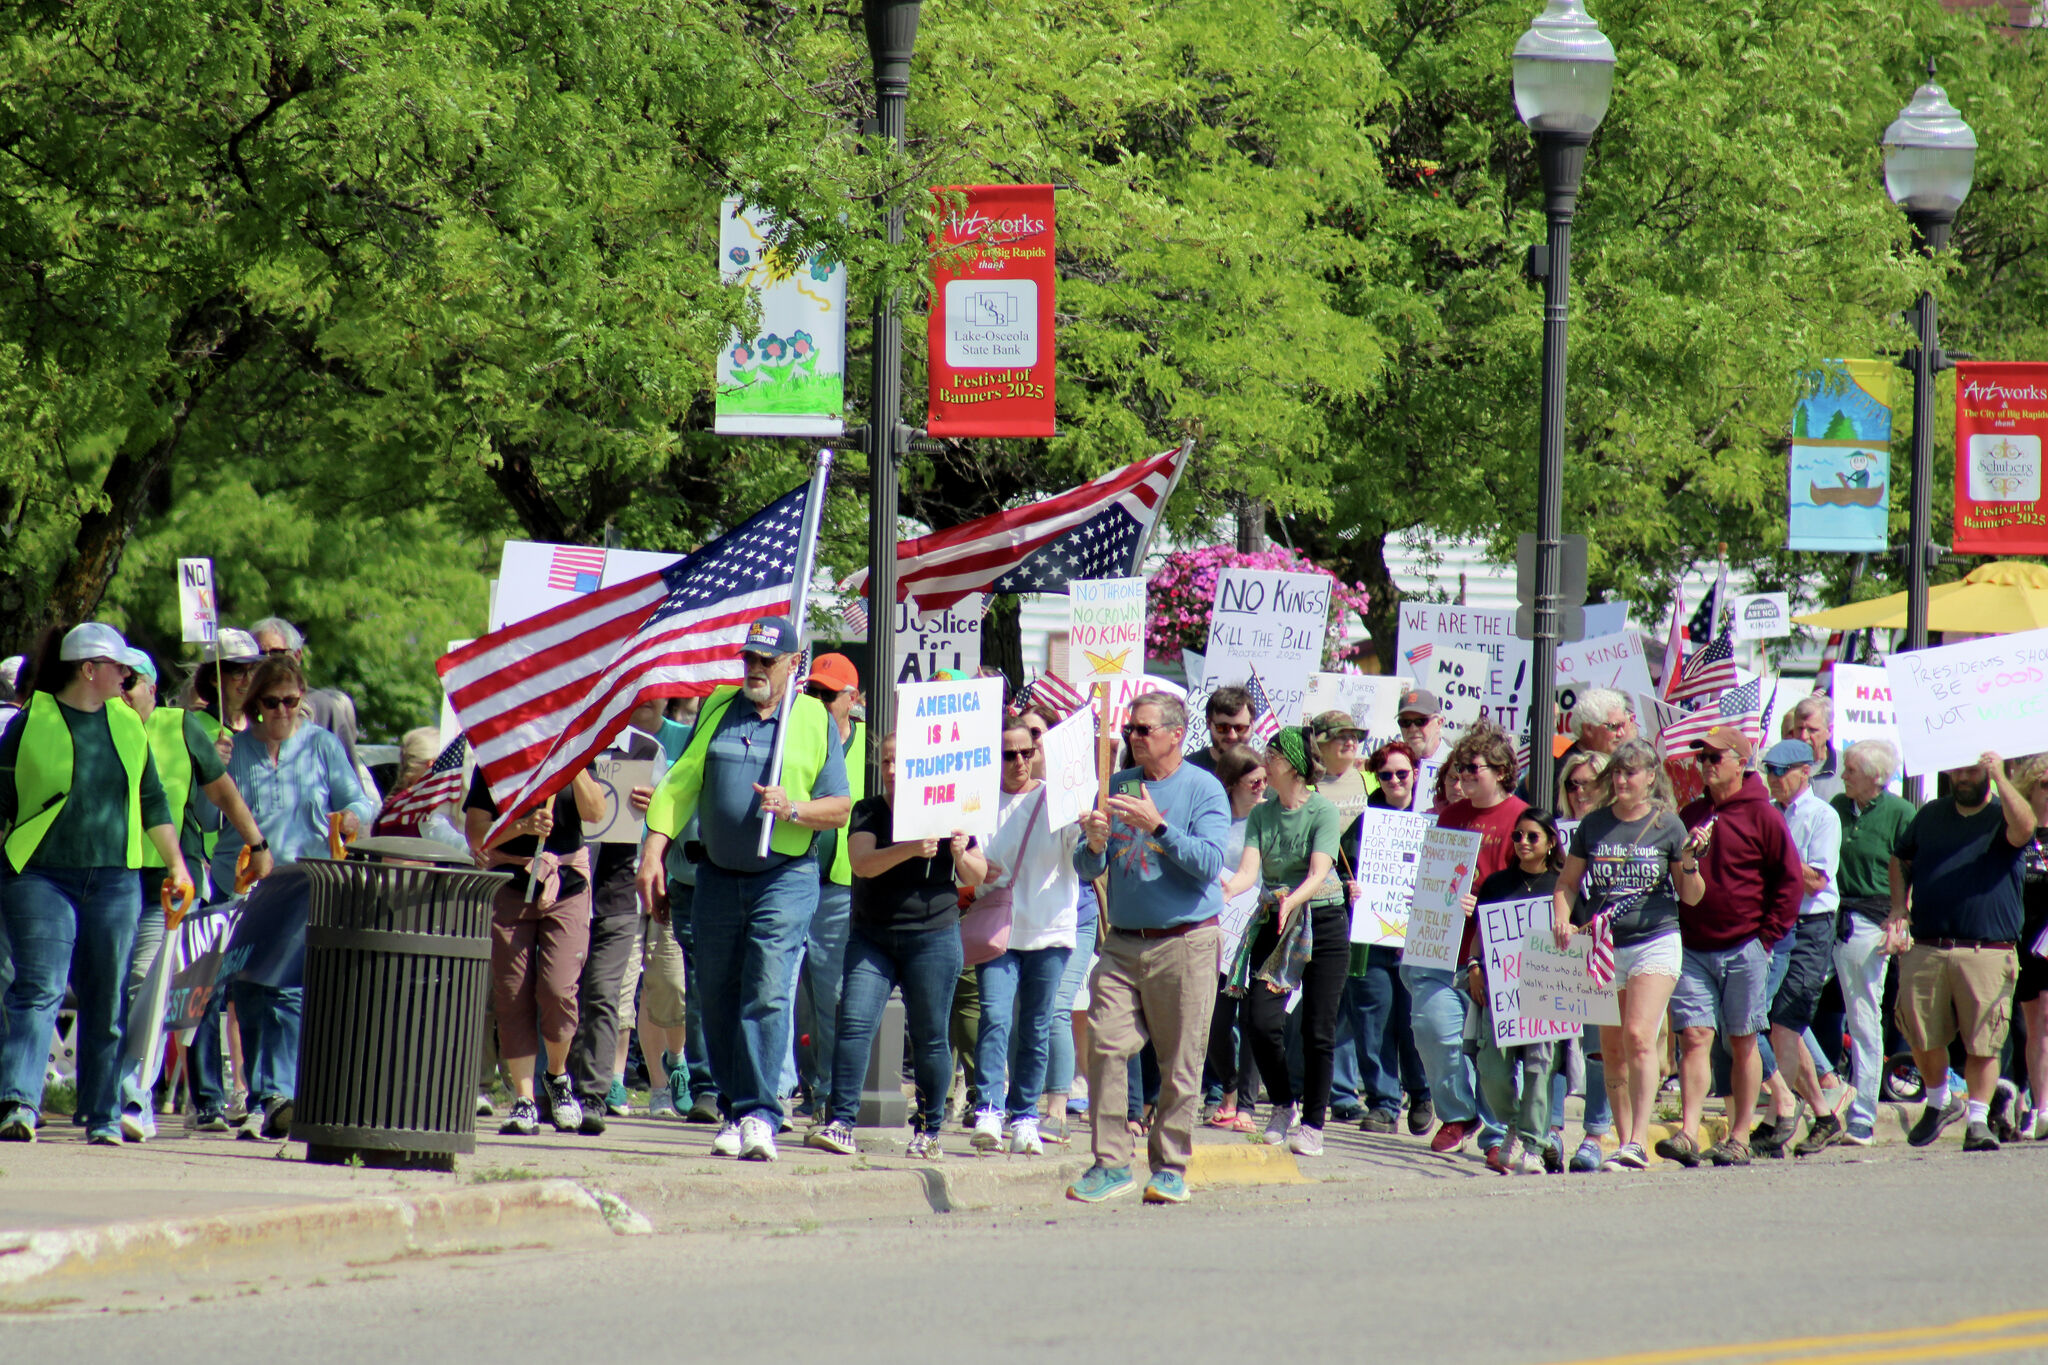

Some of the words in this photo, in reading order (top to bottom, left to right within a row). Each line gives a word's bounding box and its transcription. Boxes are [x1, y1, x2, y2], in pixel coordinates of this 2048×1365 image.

[1013, 247, 1046, 259] Rapids
[955, 330, 1029, 342] Lake-Osceola
[962, 344, 989, 355] State
[993, 344, 1021, 355] Bank
[953, 369, 1012, 388] Festival
[1016, 368, 1032, 382] of
[940, 387, 1002, 404] Banners
[1006, 383, 1044, 399] 2025
[1964, 380, 2048, 402] Artworks
[1963, 408, 1979, 418] The
[1980, 409, 1996, 420] City
[1997, 409, 2007, 418] of
[1975, 502, 2021, 517] Festival
[2023, 501, 2036, 513] of
[1963, 515, 2013, 529] Banners
[2016, 512, 2047, 527] 2025
[184, 564, 206, 588] NO
[1076, 584, 1098, 601] NO
[1101, 582, 1144, 601] THRONE
[1219, 578, 1265, 612] NO
[1073, 607, 1094, 624] NO
[1096, 604, 1140, 625] CROWN
[1762, 609, 1777, 617] NOT
[1405, 610, 1428, 631] WE
[1438, 612, 1468, 634] ARE
[1473, 614, 1502, 636] THE
[1750, 621, 1776, 630] KINGS
[1071, 624, 1097, 646] NO
[1100, 622, 1142, 645] KING!
[1252, 629, 1273, 648] THE
[1227, 648, 1270, 658] PROJECT
[1276, 652, 1302, 661] 2025
[1438, 660, 1464, 677] NO
[1931, 680, 1961, 700] BE
[1976, 666, 2044, 694] GOOD
[916, 691, 981, 717] AMERICA
[1846, 708, 1888, 725] WILL
[1925, 703, 1971, 734] NOT
[927, 724, 942, 745] IS
[950, 721, 960, 742] A
[905, 746, 992, 780] TRUMPSTER
[923, 783, 956, 806] FIRE
[1382, 814, 1396, 824] IF
[1371, 825, 1382, 835] IS
[1364, 836, 1386, 848] FOR
[1445, 833, 1458, 845] THE
[1363, 848, 1400, 862] THERE
[1613, 843, 1628, 857] the
[1361, 861, 1405, 874] MONEY
[1425, 862, 1432, 873] I
[1592, 863, 1613, 878] NO
[1421, 878, 1447, 893] TRUST
[1594, 877, 1607, 887] IN
[1370, 901, 1412, 915] KINGS
[1413, 907, 1423, 921] TO
[1424, 909, 1440, 926] TELL
[1440, 911, 1454, 928] ME
[1417, 925, 1449, 942] ABOUT
[1406, 939, 1451, 962] SCIENCE
[1491, 947, 1501, 969] A
[1526, 961, 1550, 973] those
[1554, 965, 1570, 975] who
[1572, 966, 1583, 977] do
[1546, 983, 1555, 991] in
[1556, 980, 1573, 993] the
[1554, 996, 1588, 1017] Evil
[1497, 1019, 1516, 1039] BE
